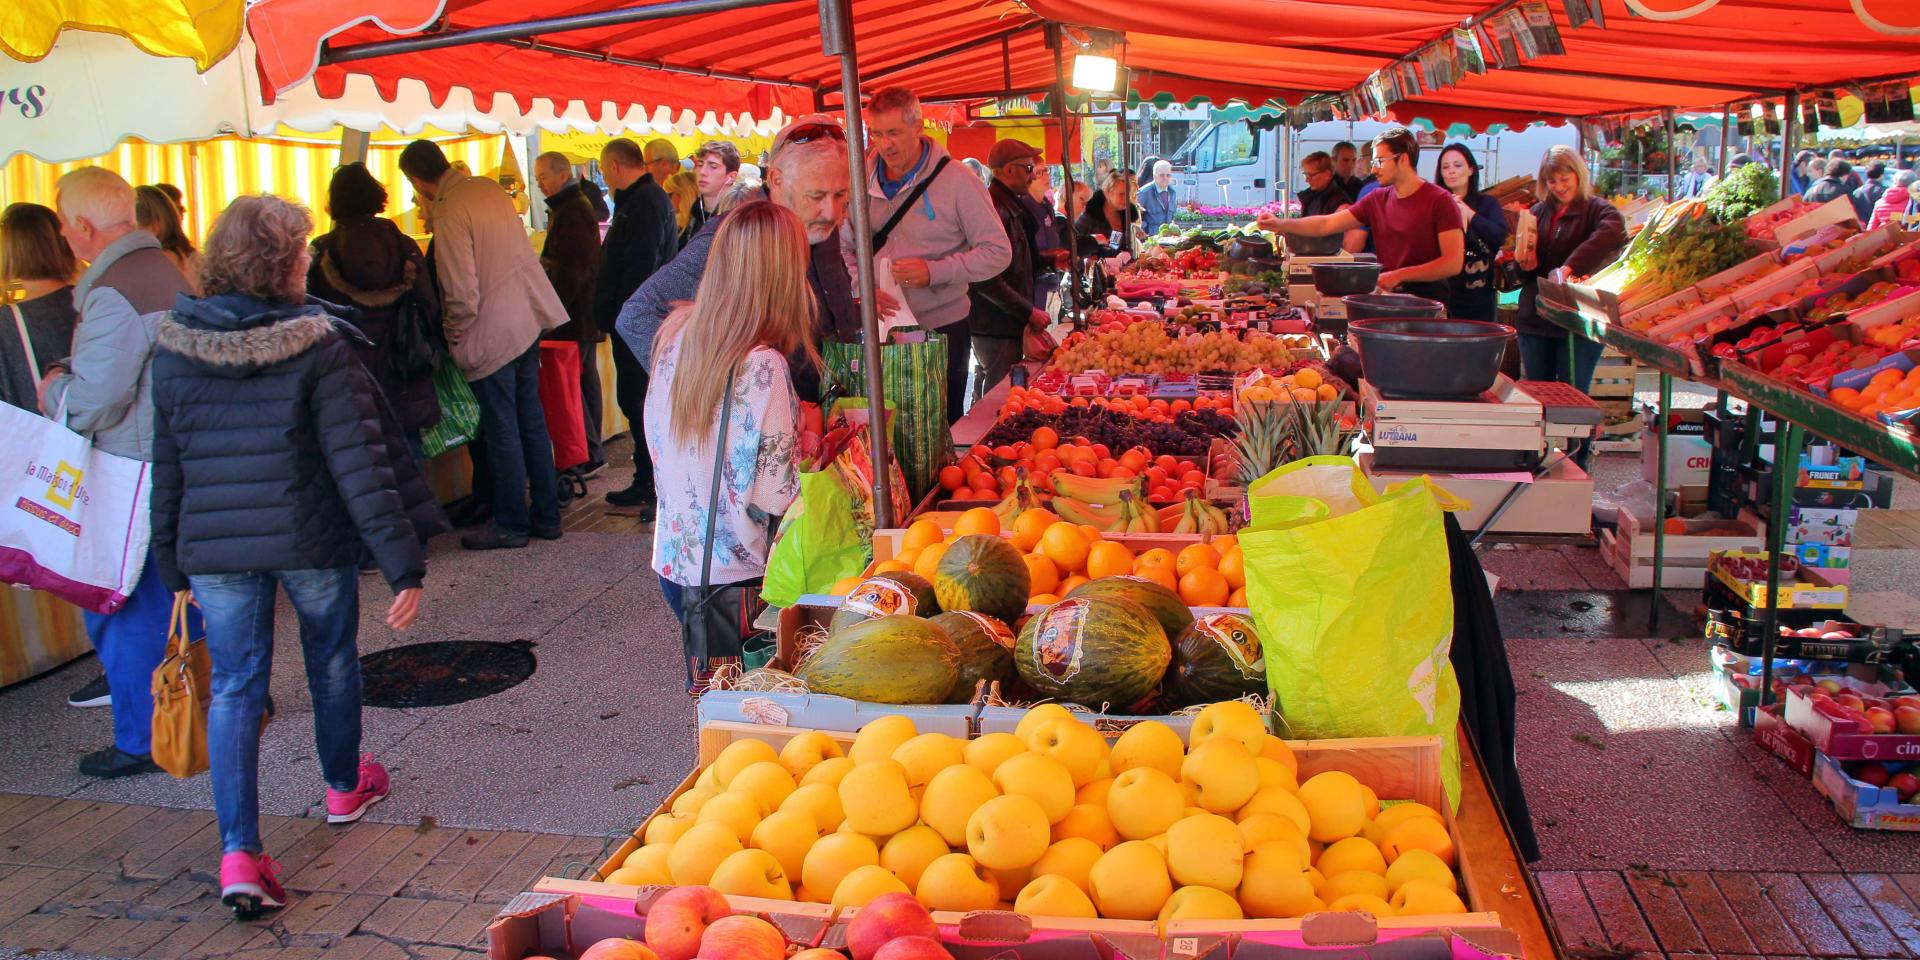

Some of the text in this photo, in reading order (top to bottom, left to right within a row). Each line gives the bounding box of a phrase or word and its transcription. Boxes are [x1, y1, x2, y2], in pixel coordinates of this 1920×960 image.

[1378, 431, 1417, 442] LUTRANA
[25, 461, 35, 476] la
[1809, 471, 1840, 480] FRUNET
[1180, 939, 1193, 951] 28
